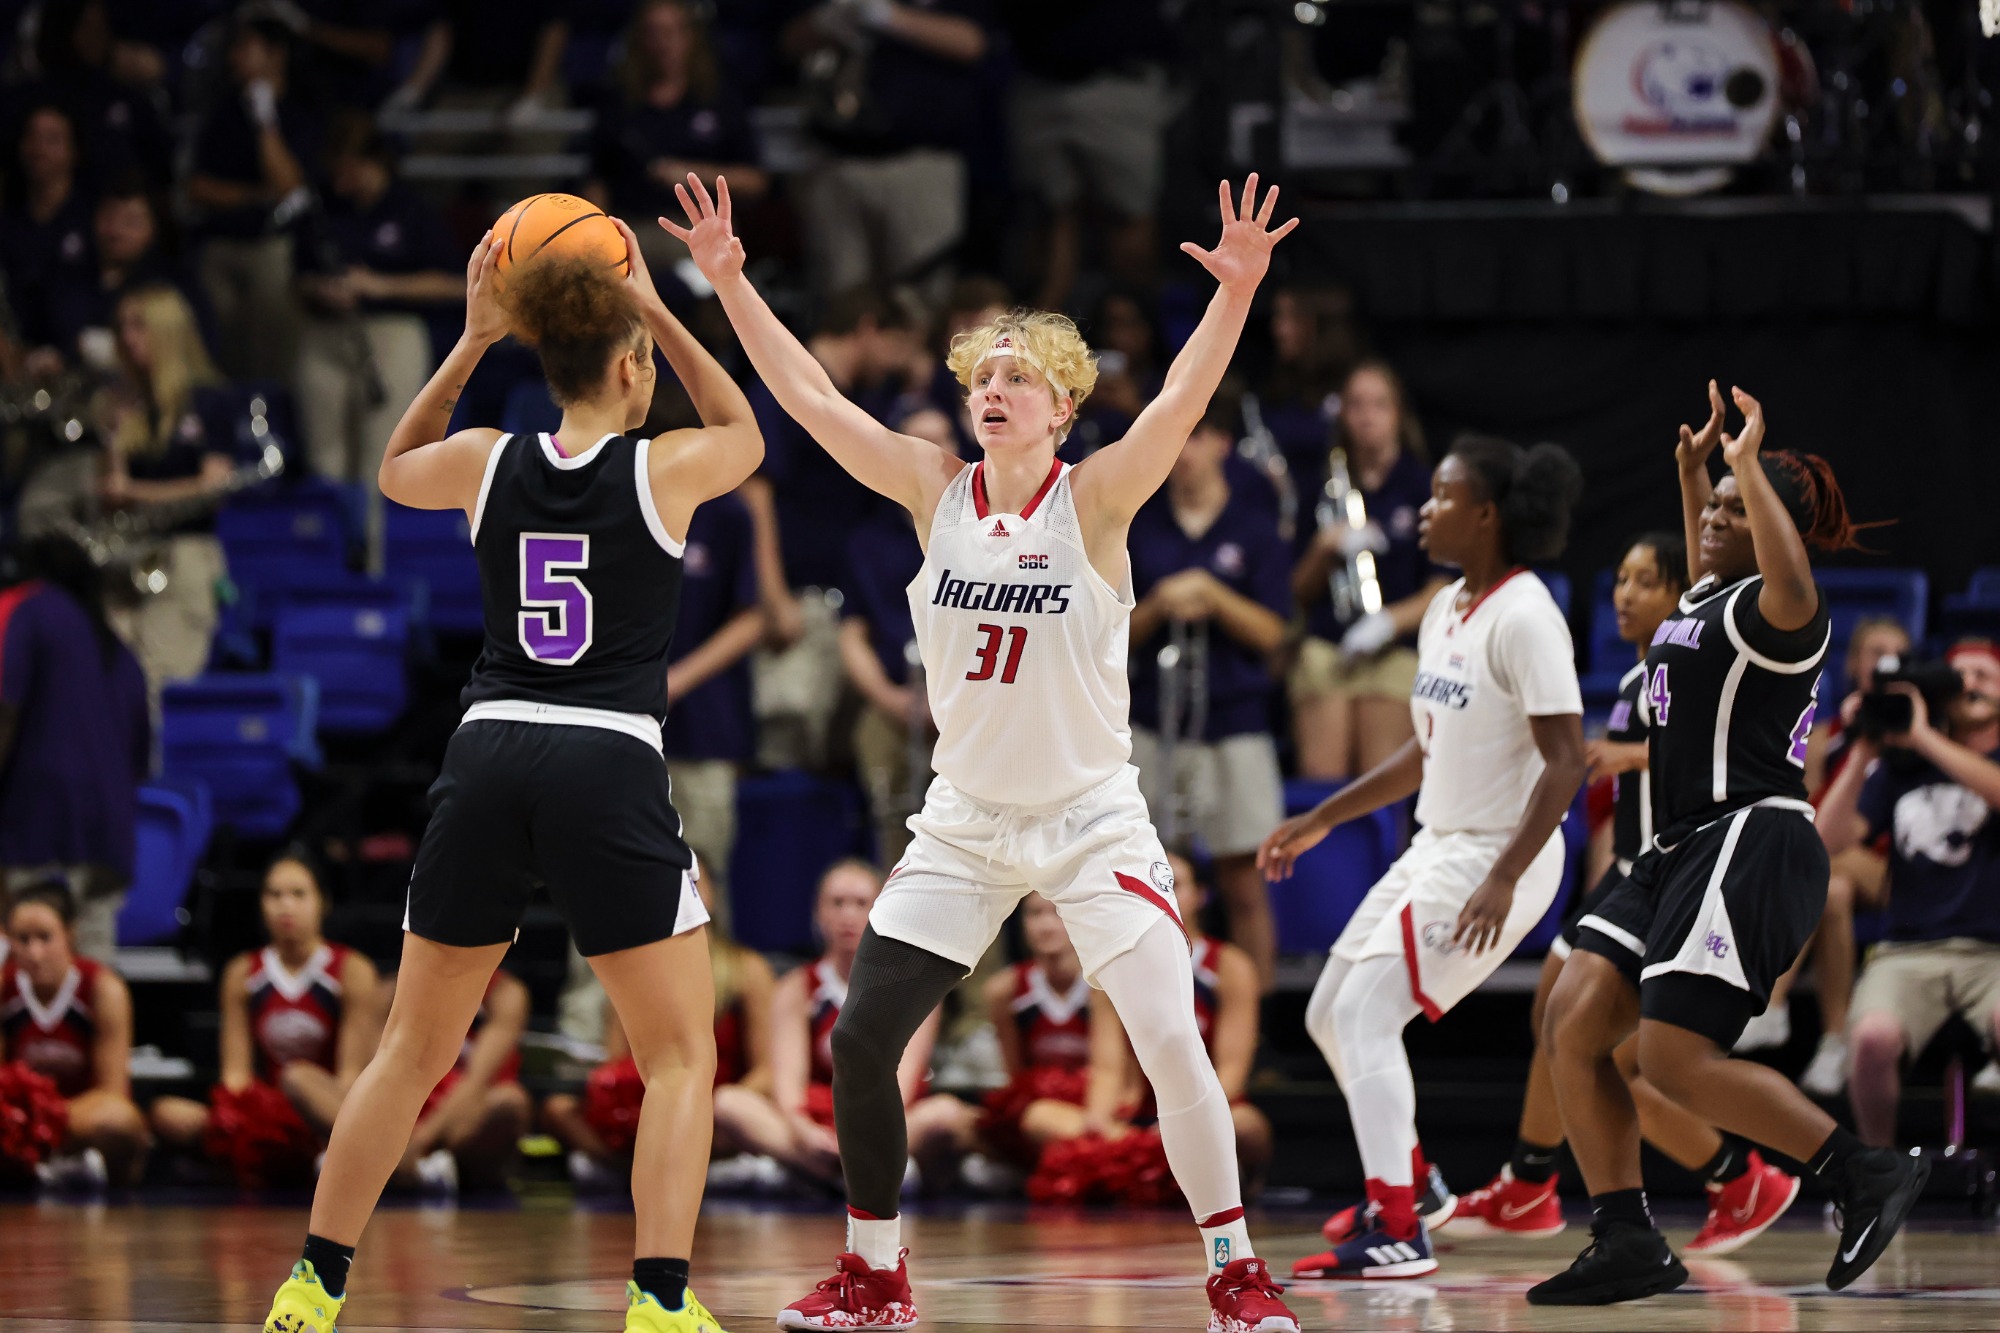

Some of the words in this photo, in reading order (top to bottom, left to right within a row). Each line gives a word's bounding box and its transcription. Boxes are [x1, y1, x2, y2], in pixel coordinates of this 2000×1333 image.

[987, 529, 1010, 537] adidas
[1018, 554, 1049, 570] SBC
[517, 531, 594, 667] 5
[965, 623, 1028, 684] 31
[1642, 663, 1672, 727] 4
